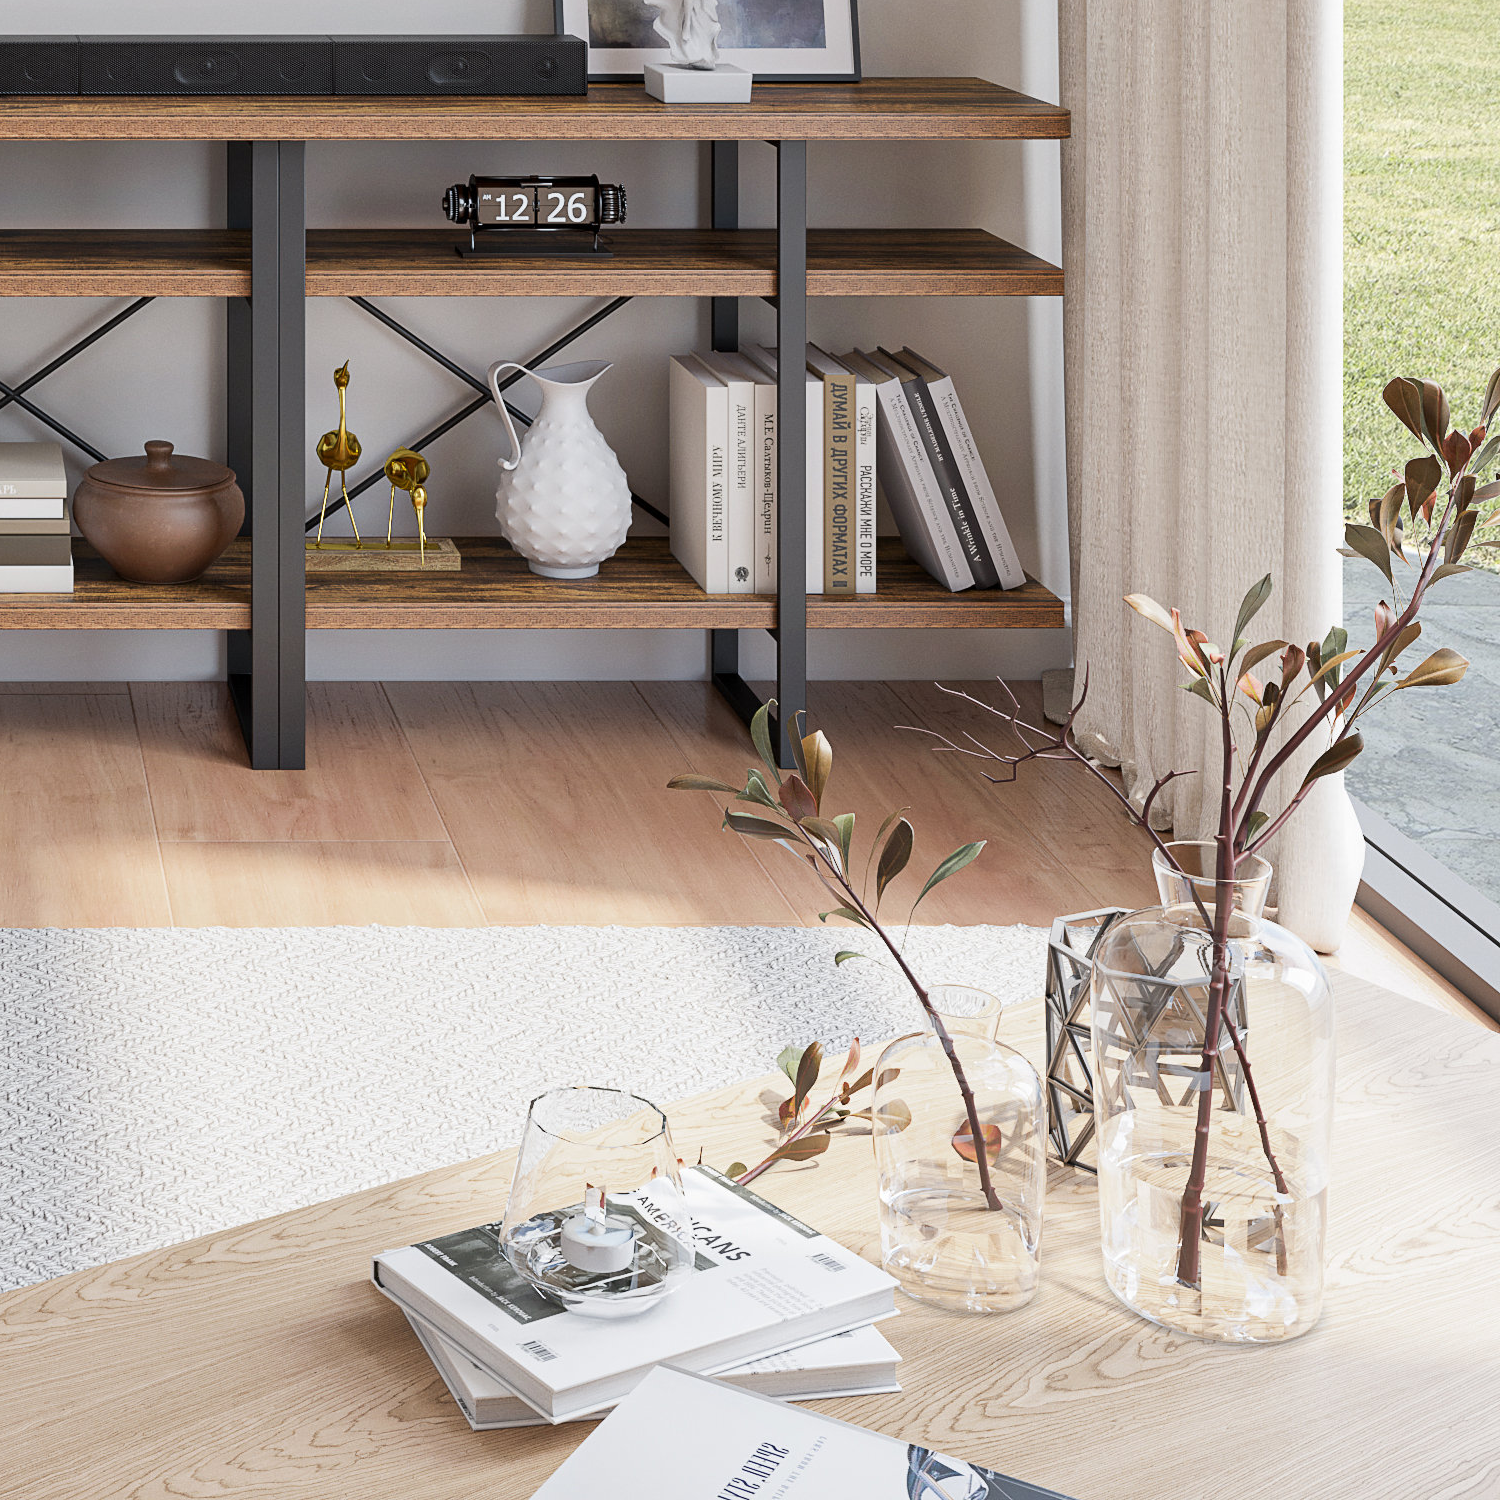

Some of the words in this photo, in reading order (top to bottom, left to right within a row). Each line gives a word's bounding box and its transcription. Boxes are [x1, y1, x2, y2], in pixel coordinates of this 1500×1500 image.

[495, 194, 530, 221] 12
[547, 192, 588, 223] 26
[736, 404, 746, 437] ДАНТЕ
[830, 382, 851, 431] ДУМАЙ
[832, 435, 848, 443] В
[712, 445, 723, 478] МИРУ
[736, 438, 746, 490] АЛИГЬЕРИ
[831, 447, 848, 500] ДРУГИХ
[761, 437, 774, 535] Салтыков-Щедрин
[860, 465, 873, 517] РАССКАЖИ
[949, 487, 961, 511] Time
[712, 481, 723, 532] ВЕЧНОМУ
[958, 509, 966, 520] in
[712, 534, 723, 542] К
[832, 504, 848, 576] ФОРМАТАХ
[860, 518, 873, 539] МНЕ
[960, 520, 978, 556] Wrinkle
[860, 551, 873, 578] МОРЕ
